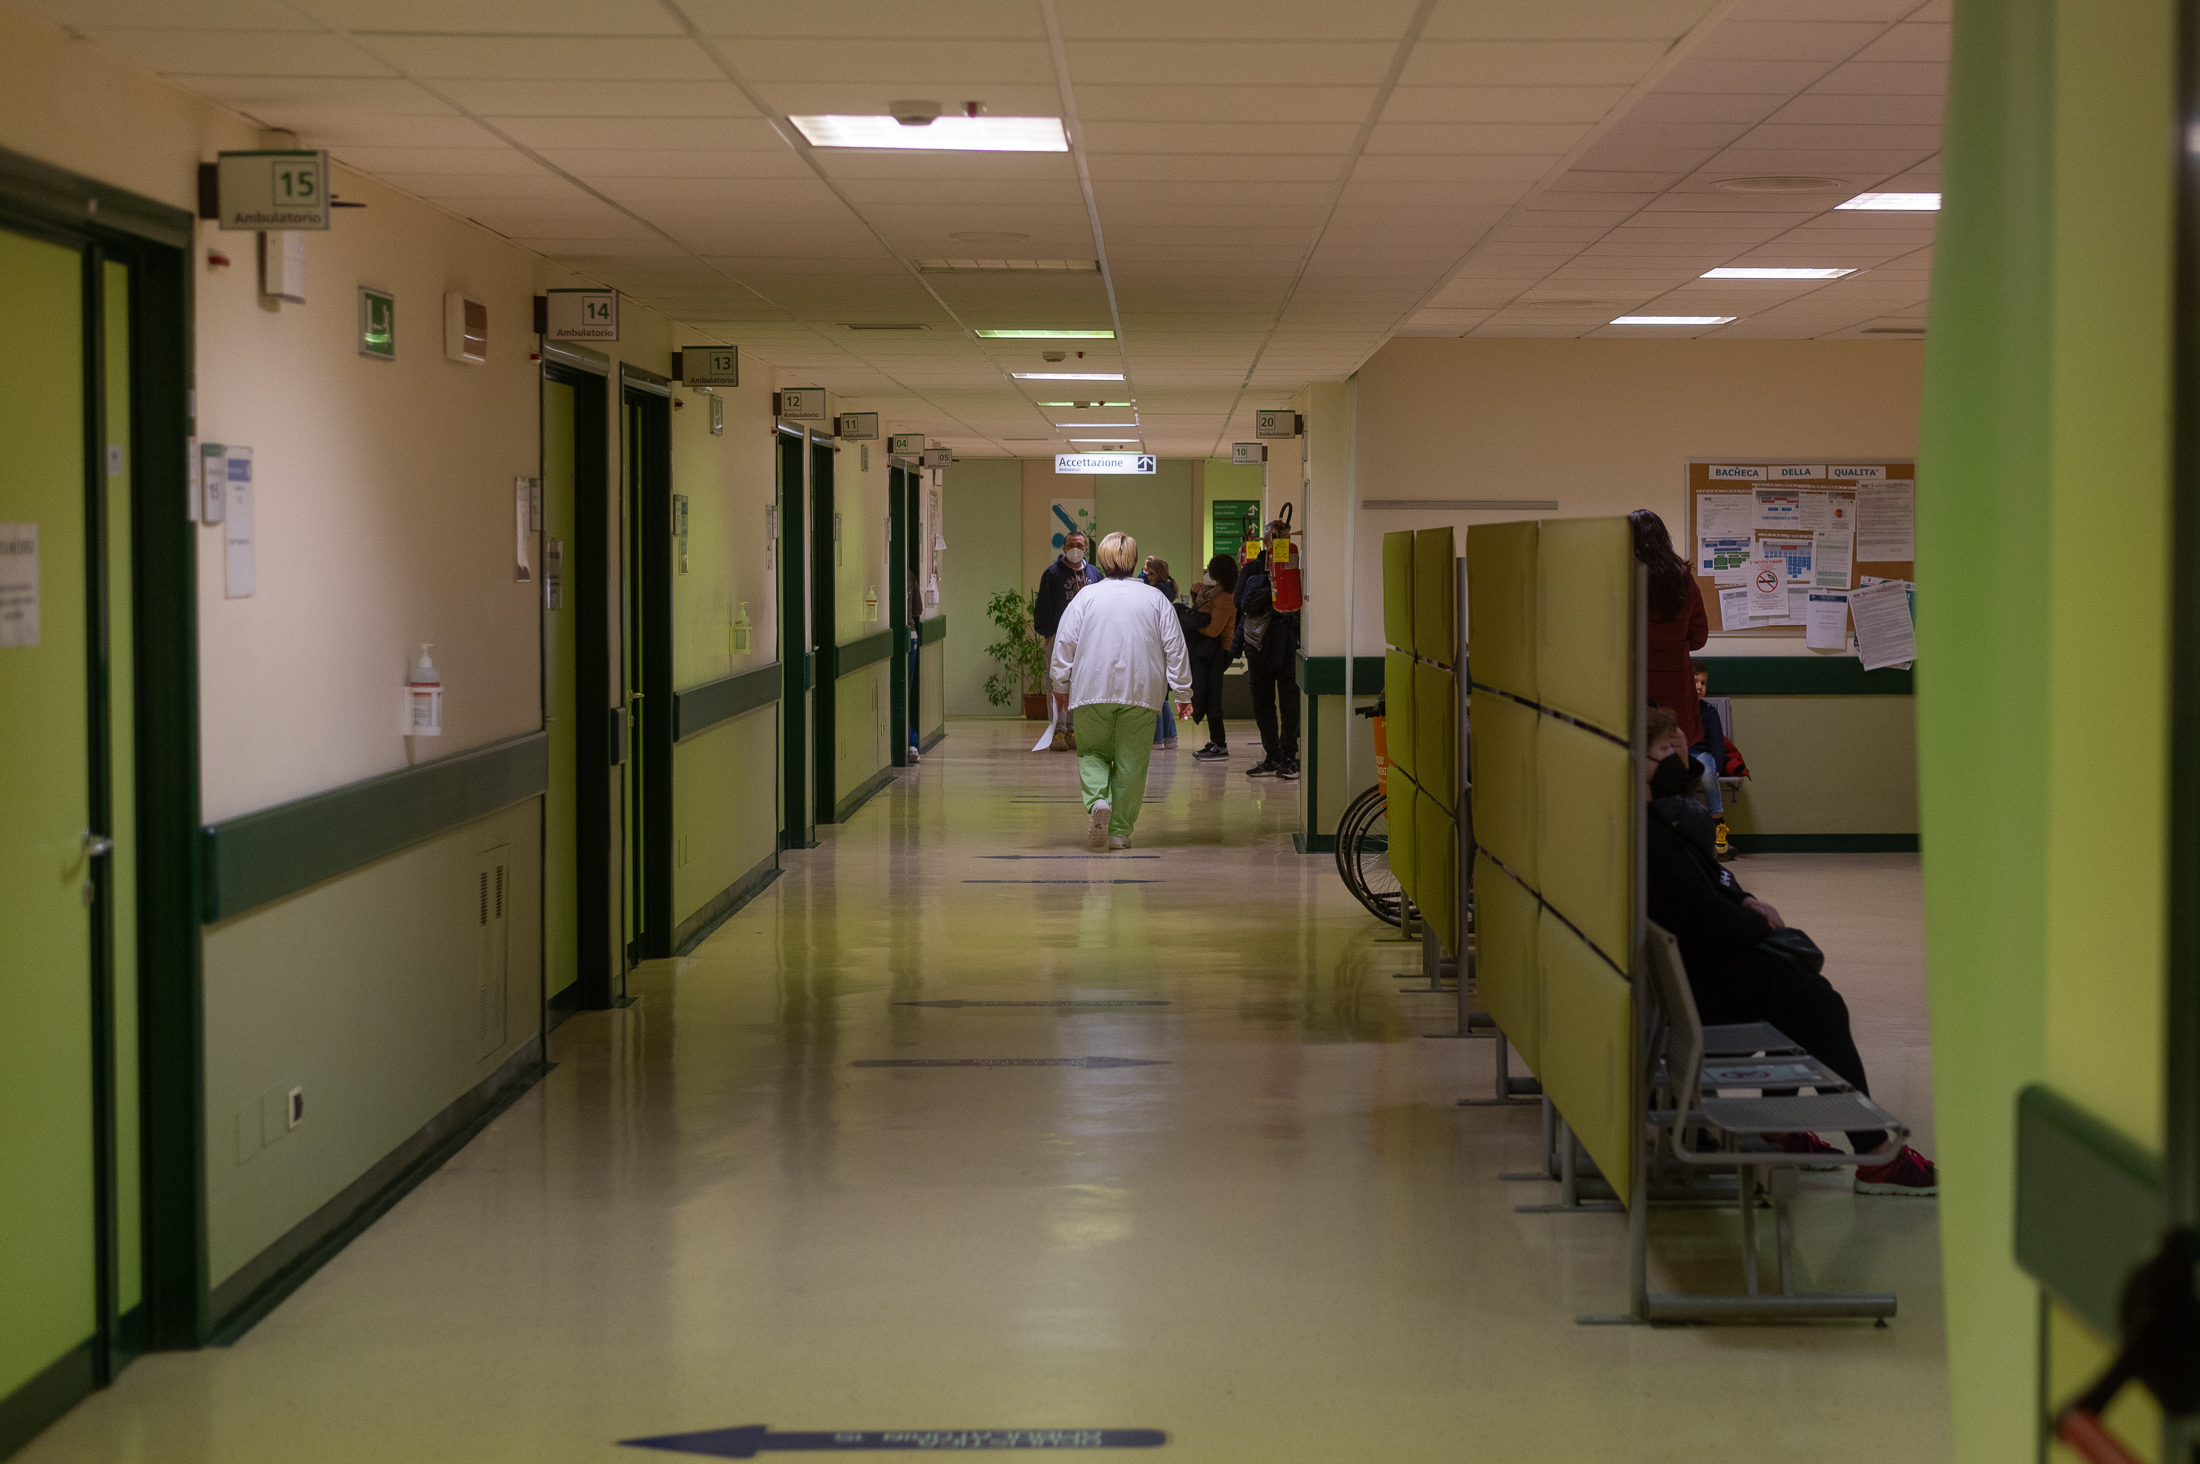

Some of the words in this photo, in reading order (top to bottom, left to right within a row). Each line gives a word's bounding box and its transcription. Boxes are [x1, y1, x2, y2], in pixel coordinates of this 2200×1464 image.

[281, 171, 314, 197] 15
[235, 211, 322, 224] Ambulatorio
[587, 302, 609, 319] 14
[557, 328, 614, 337] Ambulatorio
[713, 356, 731, 370] 13
[690, 376, 735, 384] Ambulatorio
[786, 396, 800, 407] 12
[845, 420, 856, 429] 11
[1261, 417, 1274, 427] 20
[896, 439, 907, 448] 04
[1236, 448, 1246, 456] 10
[939, 453, 949, 461] 05
[1058, 457, 1123, 467] Accettazione
[1715, 468, 1759, 477] BACHECA
[1781, 468, 1811, 476] DELLA
